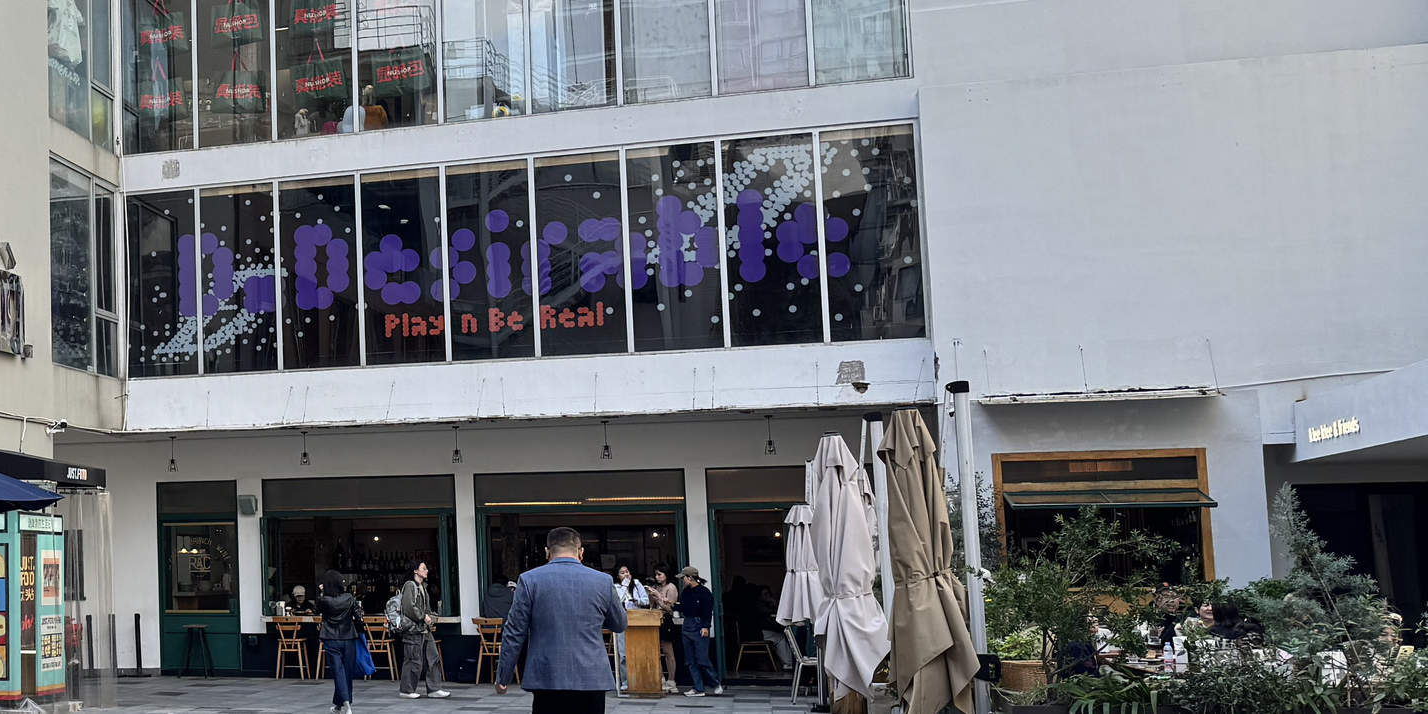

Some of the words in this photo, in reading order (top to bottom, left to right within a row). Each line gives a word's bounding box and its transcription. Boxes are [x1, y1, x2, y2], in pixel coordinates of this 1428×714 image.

[385, 313, 445, 338] Play
[461, 313, 478, 334] n
[488, 307, 524, 332] Be
[540, 301, 604, 329] Real
